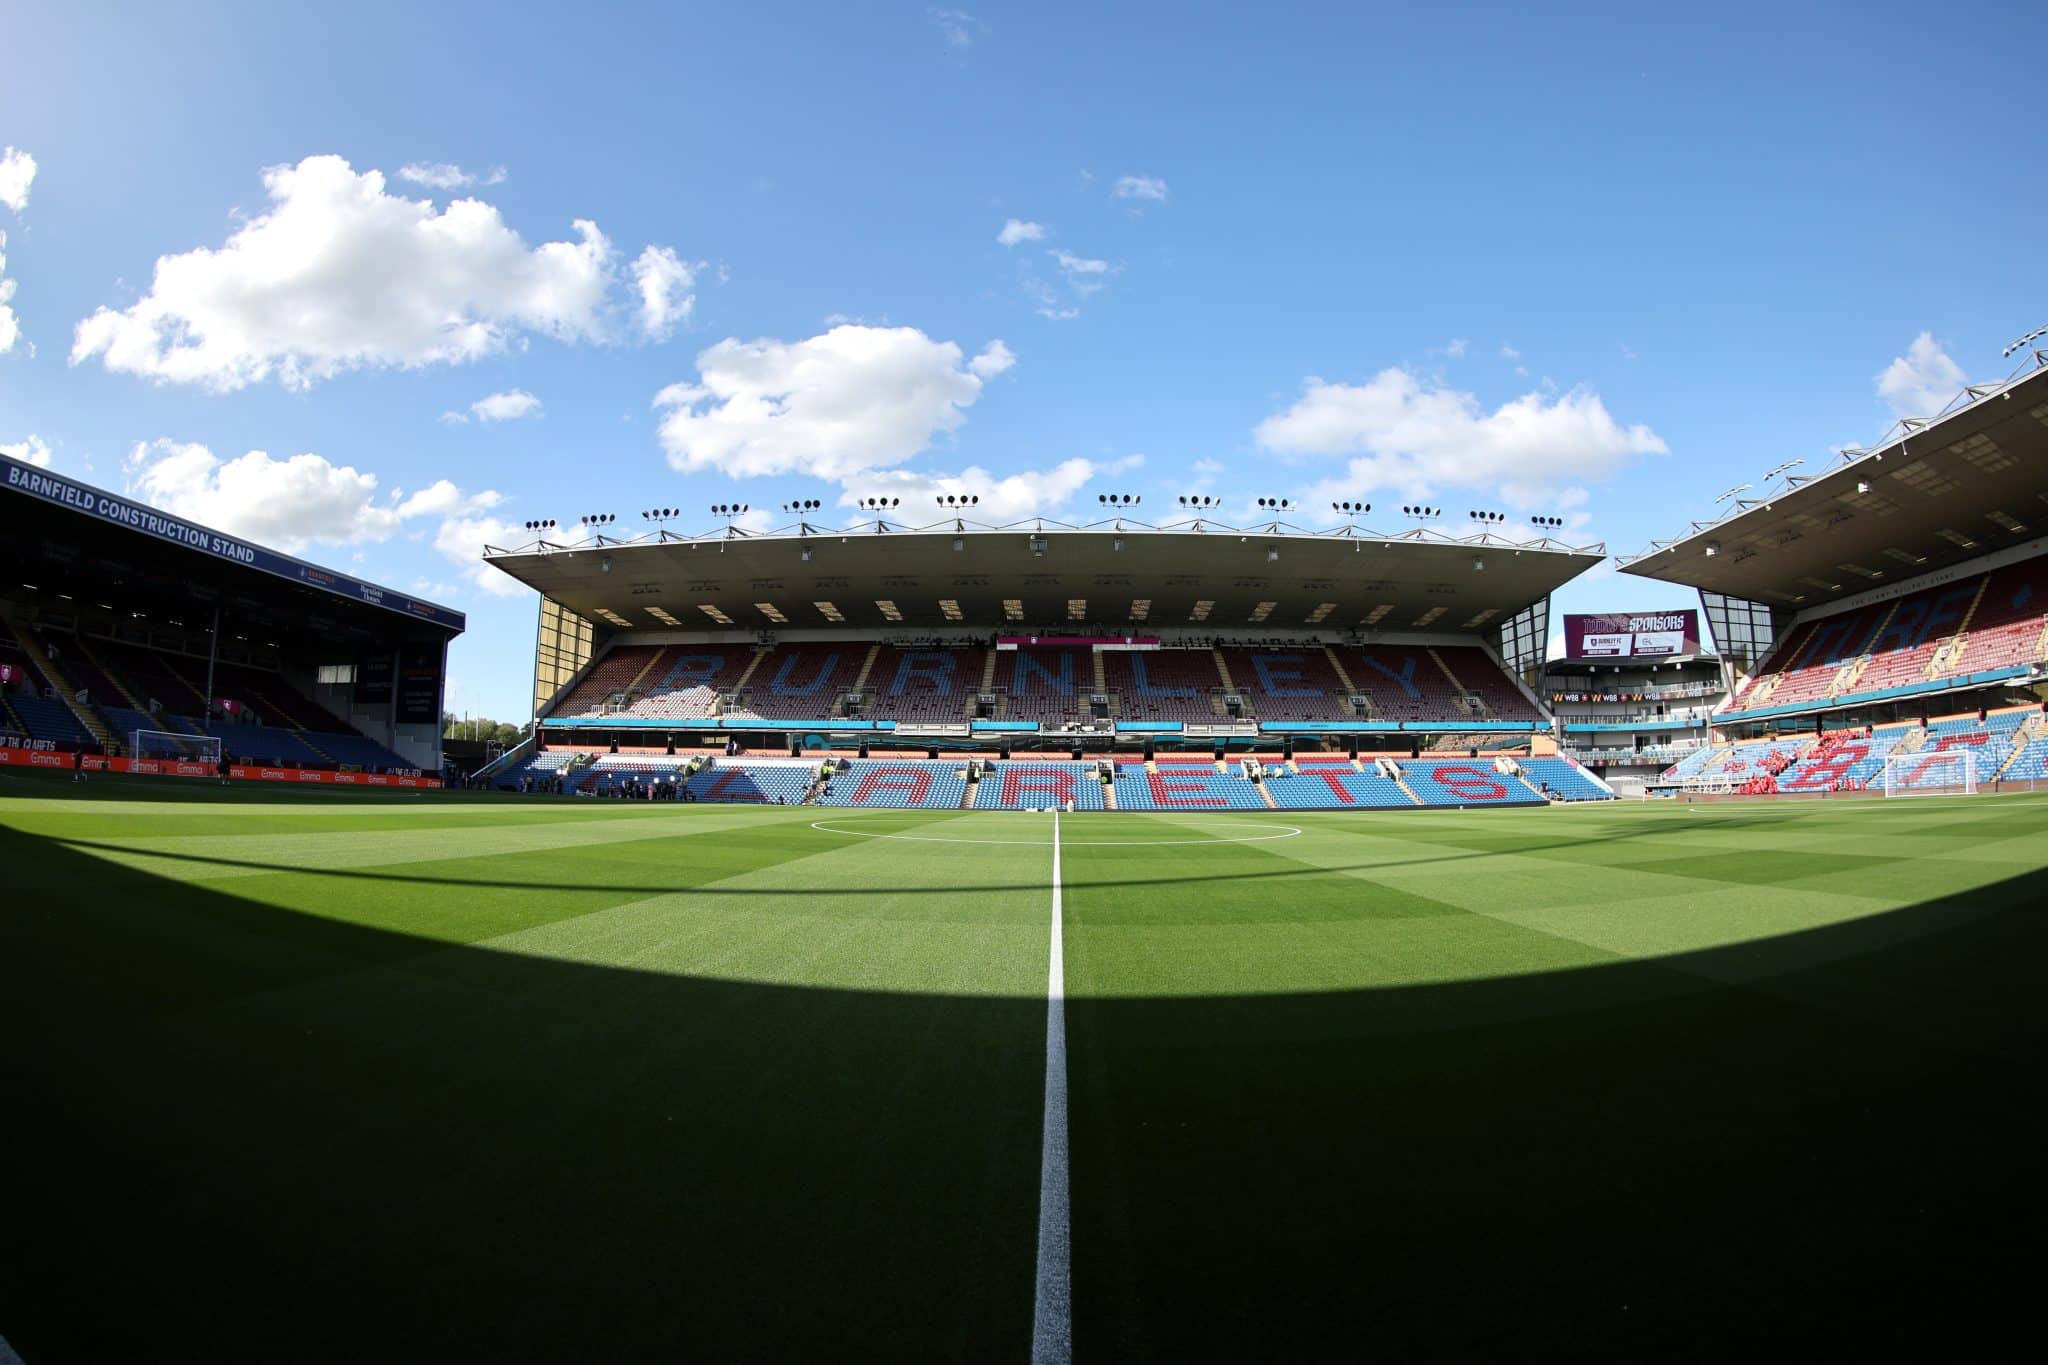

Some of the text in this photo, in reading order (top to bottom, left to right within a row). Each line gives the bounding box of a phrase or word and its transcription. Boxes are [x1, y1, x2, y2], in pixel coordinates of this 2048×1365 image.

[8, 466, 255, 563] BARNFIELD CONSTRUCTION STAND
[1629, 615, 1684, 632] SPONSORS
[649, 651, 1421, 699] BURNLEY
[31, 752, 61, 765] Emma
[131, 760, 158, 772] Emma
[177, 763, 203, 774] Emma
[261, 768, 285, 779] Emma
[300, 771, 320, 781] Emma
[335, 772, 355, 783] Emma
[577, 760, 1508, 803] CLARETS
